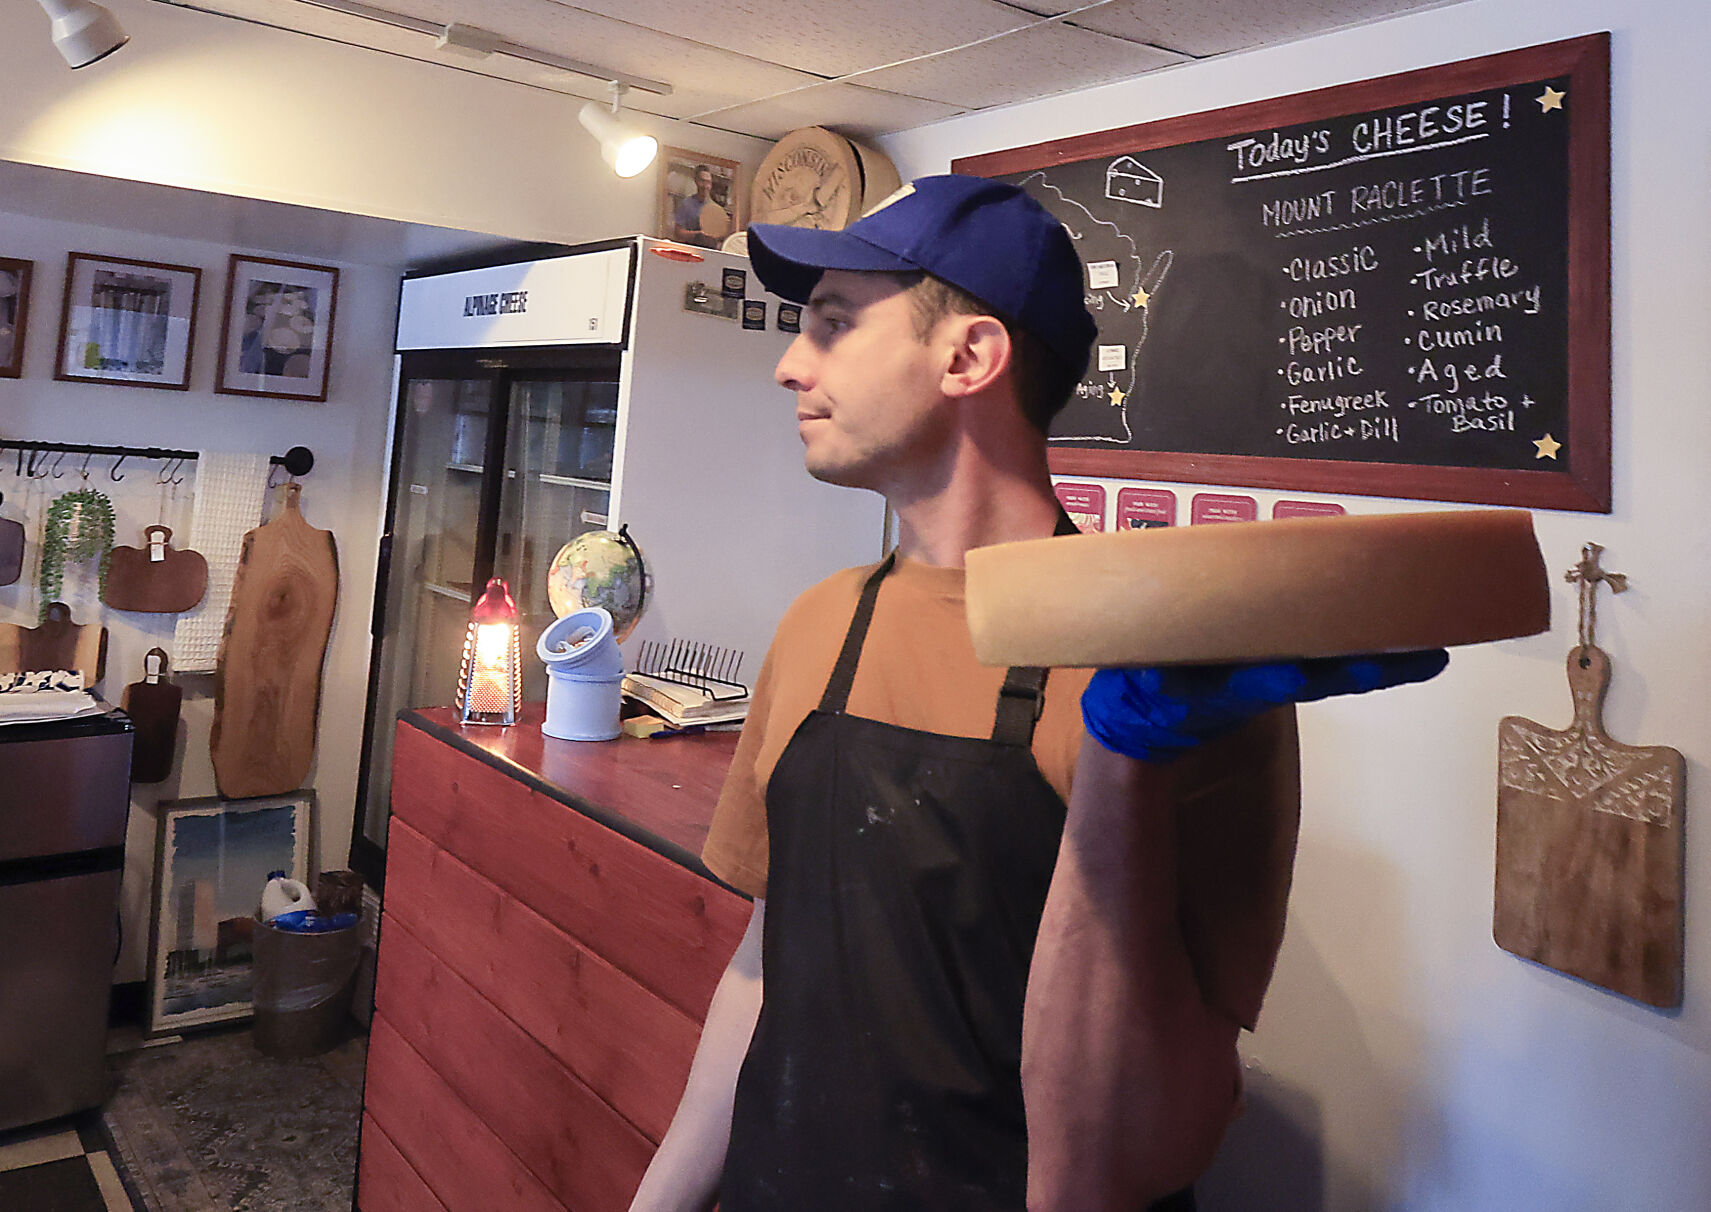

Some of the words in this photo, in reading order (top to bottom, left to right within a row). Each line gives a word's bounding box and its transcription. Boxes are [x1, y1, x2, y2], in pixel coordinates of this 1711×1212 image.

[1226, 129, 1330, 171] Today's
[1352, 101, 1488, 154] CHEESE
[1262, 190, 1336, 226] MOUNT
[1351, 168, 1492, 214] RACLETTE
[1425, 217, 1493, 262] Mild
[1416, 257, 1519, 290] Truffle
[1423, 284, 1541, 320] Rosemary
[1288, 323, 1363, 355] Pepper
[1418, 320, 1502, 351] Cumin
[1286, 356, 1363, 386] Garlic
[1416, 354, 1507, 394] Aged
[1288, 390, 1390, 418] Fenugreek
[1418, 390, 1507, 415] Tomato
[1360, 416, 1399, 442] Dill
[1451, 410, 1515, 433] Basil
